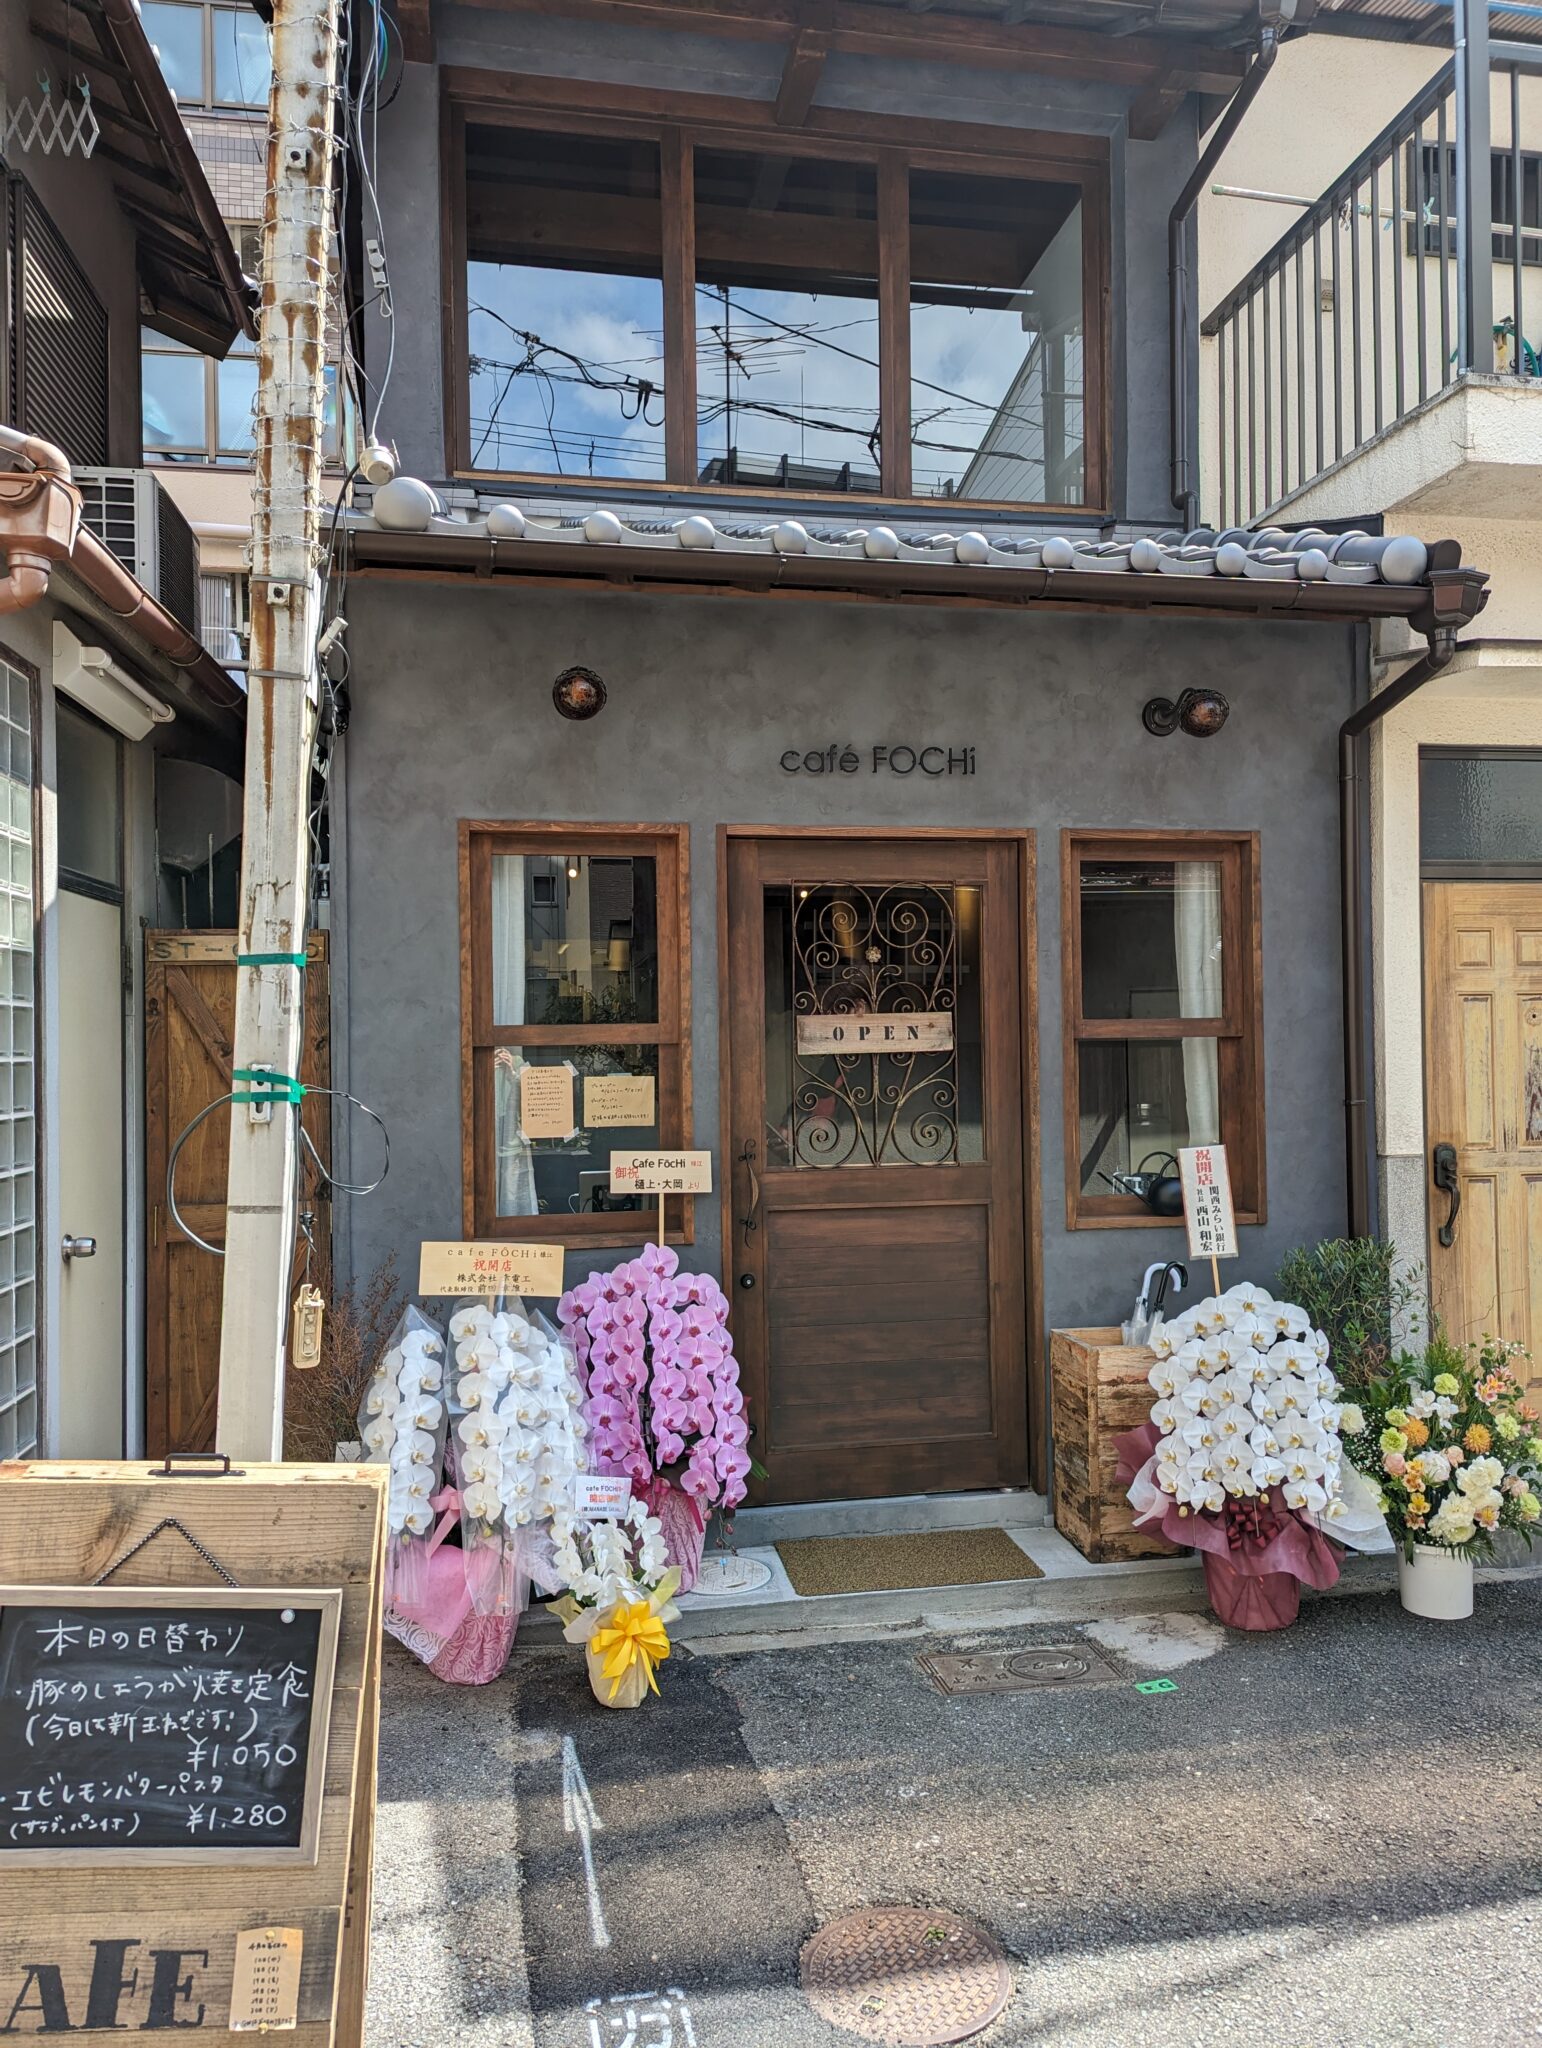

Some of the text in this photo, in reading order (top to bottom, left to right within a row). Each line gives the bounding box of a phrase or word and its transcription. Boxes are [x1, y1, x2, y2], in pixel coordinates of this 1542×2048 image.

[779, 744, 859, 773] café
[832, 1025, 919, 1041] OPEN
[615, 1166, 639, 1179] 御祝
[632, 1159, 655, 1168] Cafe
[1195, 1149, 1213, 1185] 祝開店
[1209, 1186, 1225, 1252] 関西みらい銀行
[473, 1259, 513, 1272] 祝開店
[36, 1619, 244, 1657] 本日の日替わり
